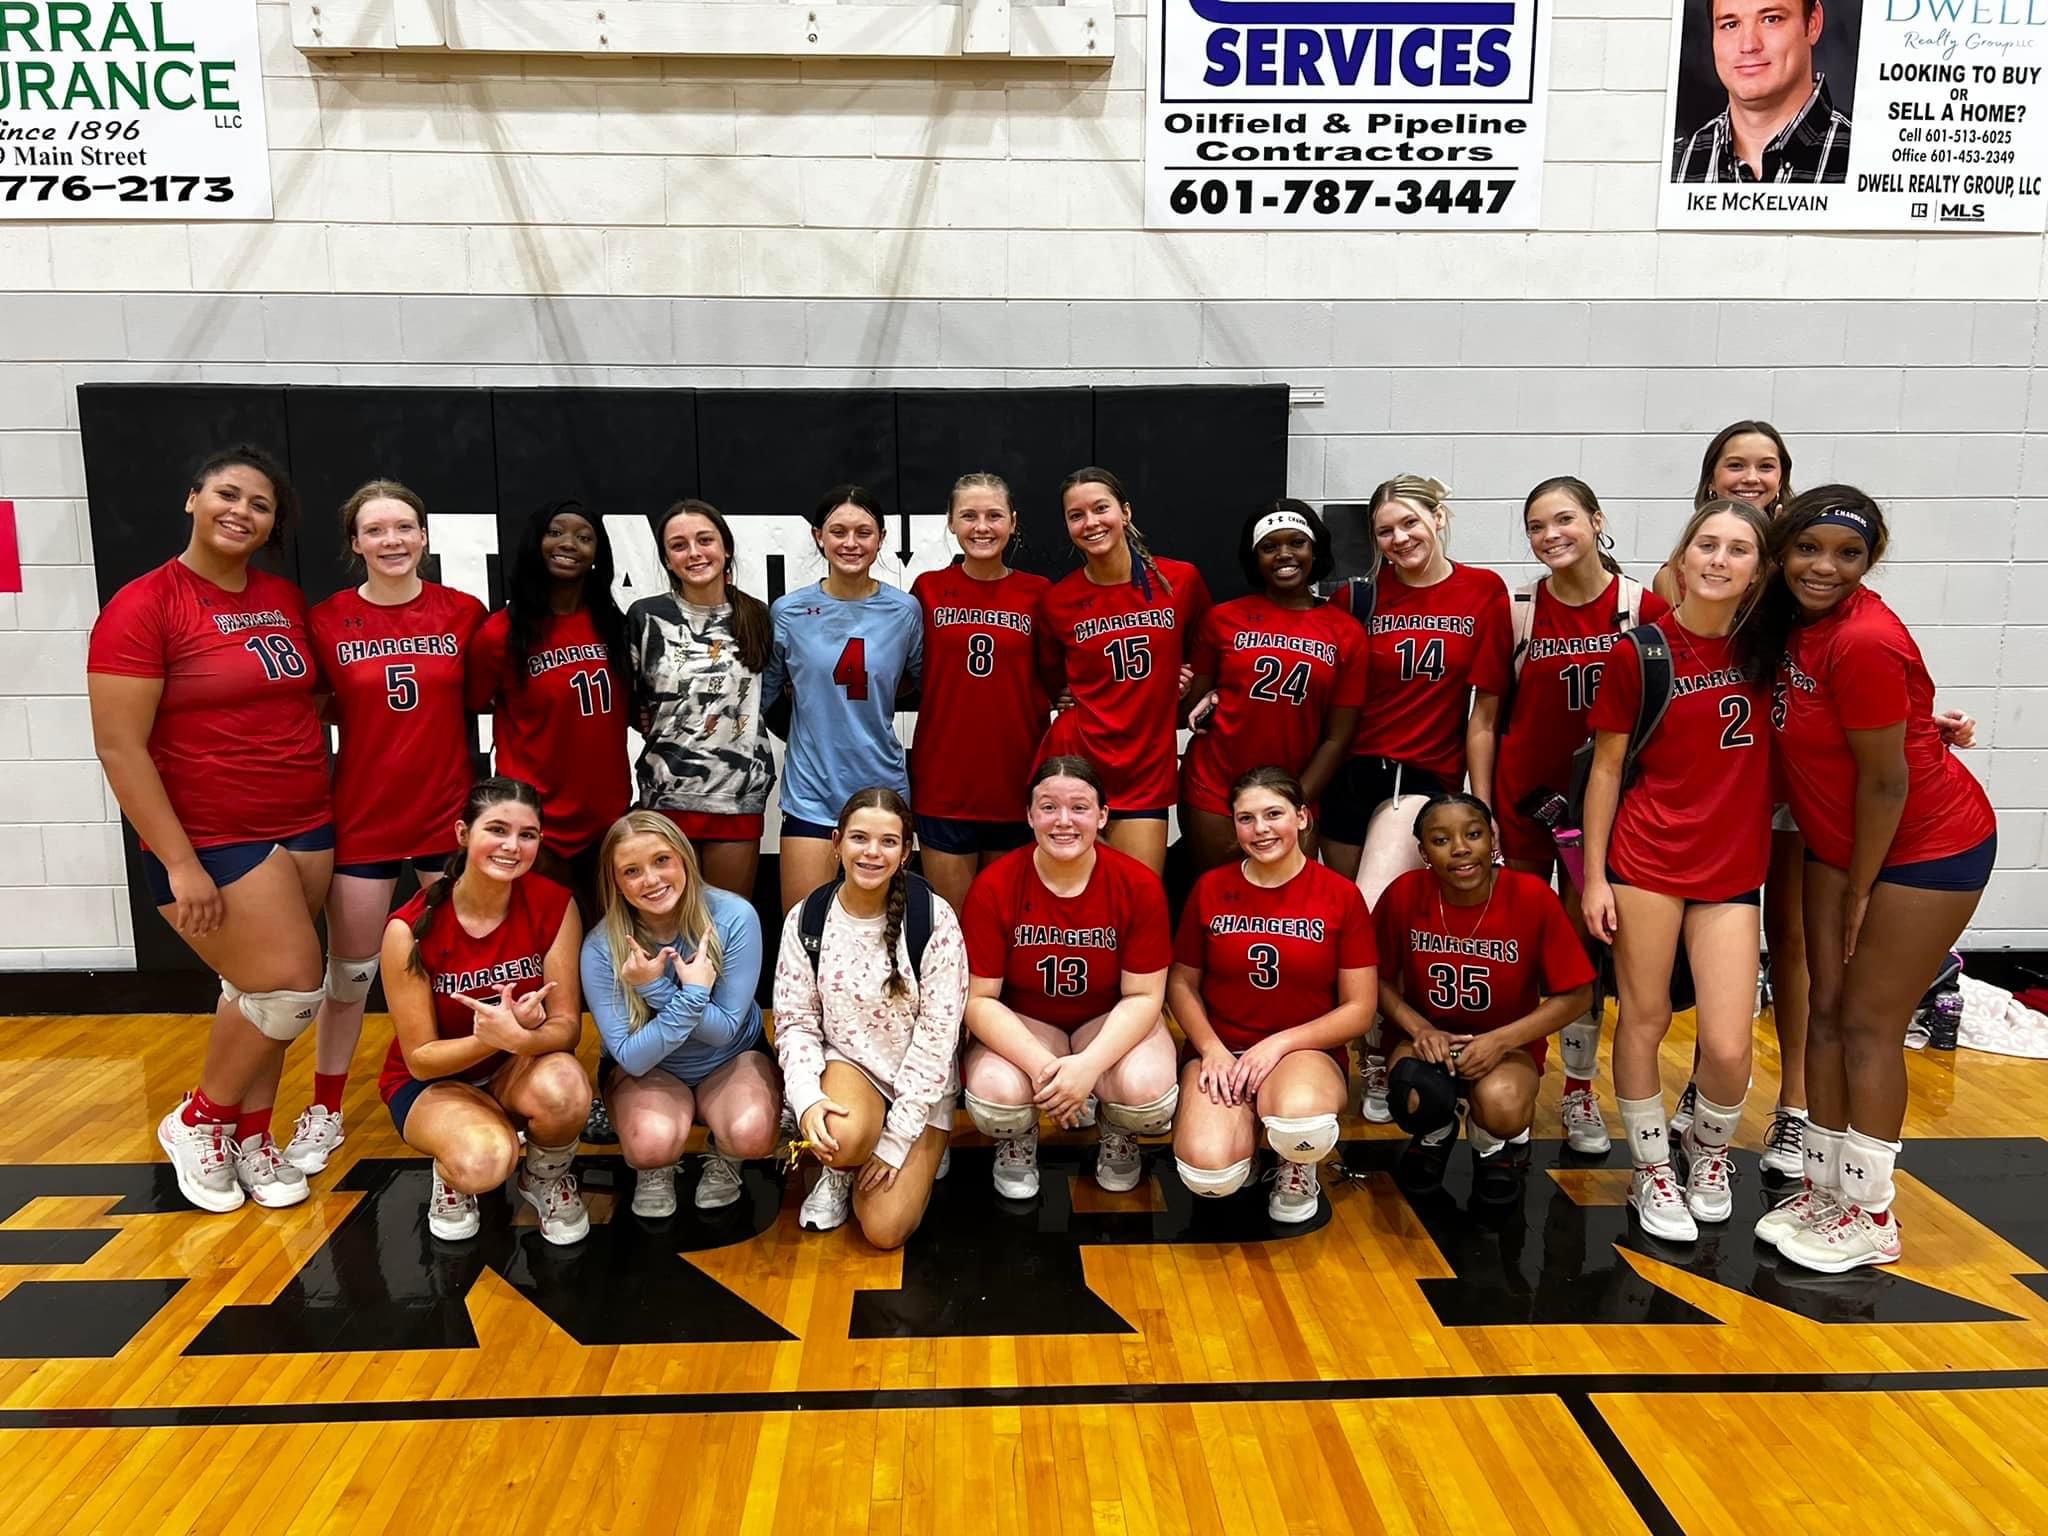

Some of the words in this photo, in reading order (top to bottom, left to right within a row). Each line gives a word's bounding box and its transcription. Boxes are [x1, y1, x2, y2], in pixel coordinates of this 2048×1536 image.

[1203, 27, 1512, 87] SERVICES
[1903, 27, 1958, 61] Realty
[1964, 32, 2014, 57] Group
[0, 60, 241, 111] RANCE
[1879, 62, 1966, 83] LOOKING
[1972, 65, 1996, 84] TO
[2002, 66, 2043, 85] BUY
[1950, 87, 1969, 101] OR
[0, 118, 56, 141] ince
[67, 119, 141, 141] 1896
[214, 115, 243, 129] LLC
[1164, 113, 1307, 134] Oilfield
[1322, 113, 1352, 134] &
[1367, 113, 1528, 139] Pipeline
[1888, 101, 1935, 121] SELL
[1940, 102, 1955, 122] A
[1960, 103, 2027, 124] HOME?
[1196, 141, 1494, 162] Contractors
[1899, 127, 1922, 142] Cell
[1925, 129, 2012, 144] 601-513-6025
[14, 146, 73, 166] Main
[81, 145, 148, 166] Street
[1892, 147, 1927, 162] Office
[1931, 150, 2015, 164] 601-453-2349
[1170, 179, 1516, 215] 601-787-3447
[1857, 173, 1904, 193] DWELL
[1908, 174, 1960, 194] REALTY
[1963, 175, 2014, 198] GROUP,
[2018, 176, 2042, 196] LLC
[1940, 204, 1985, 218] MLS
[934, 606, 1032, 636] CHARGERS
[1074, 607, 1175, 643] CHARGERS
[1367, 614, 1475, 637] CHARGERS
[244, 633, 307, 681] 18
[336, 633, 458, 666] CHARGERS
[527, 643, 609, 678] CHARGE
[967, 633, 994, 678] 8
[1103, 635, 1152, 682] 15
[1234, 631, 1337, 667] CHARGERS
[1394, 638, 1446, 682] 14
[1529, 632, 1621, 661] CHARGE
[832, 635, 869, 702] 4
[1248, 655, 1308, 706] 24
[1559, 661, 1606, 711] 16
[385, 663, 419, 712] 5
[569, 667, 612, 717] 11
[1719, 694, 1754, 750] 2
[1209, 914, 1325, 943] CHARGERS
[1036, 955, 1089, 998] 13
[1247, 942, 1280, 991] 3
[1427, 962, 1492, 1012] 35
